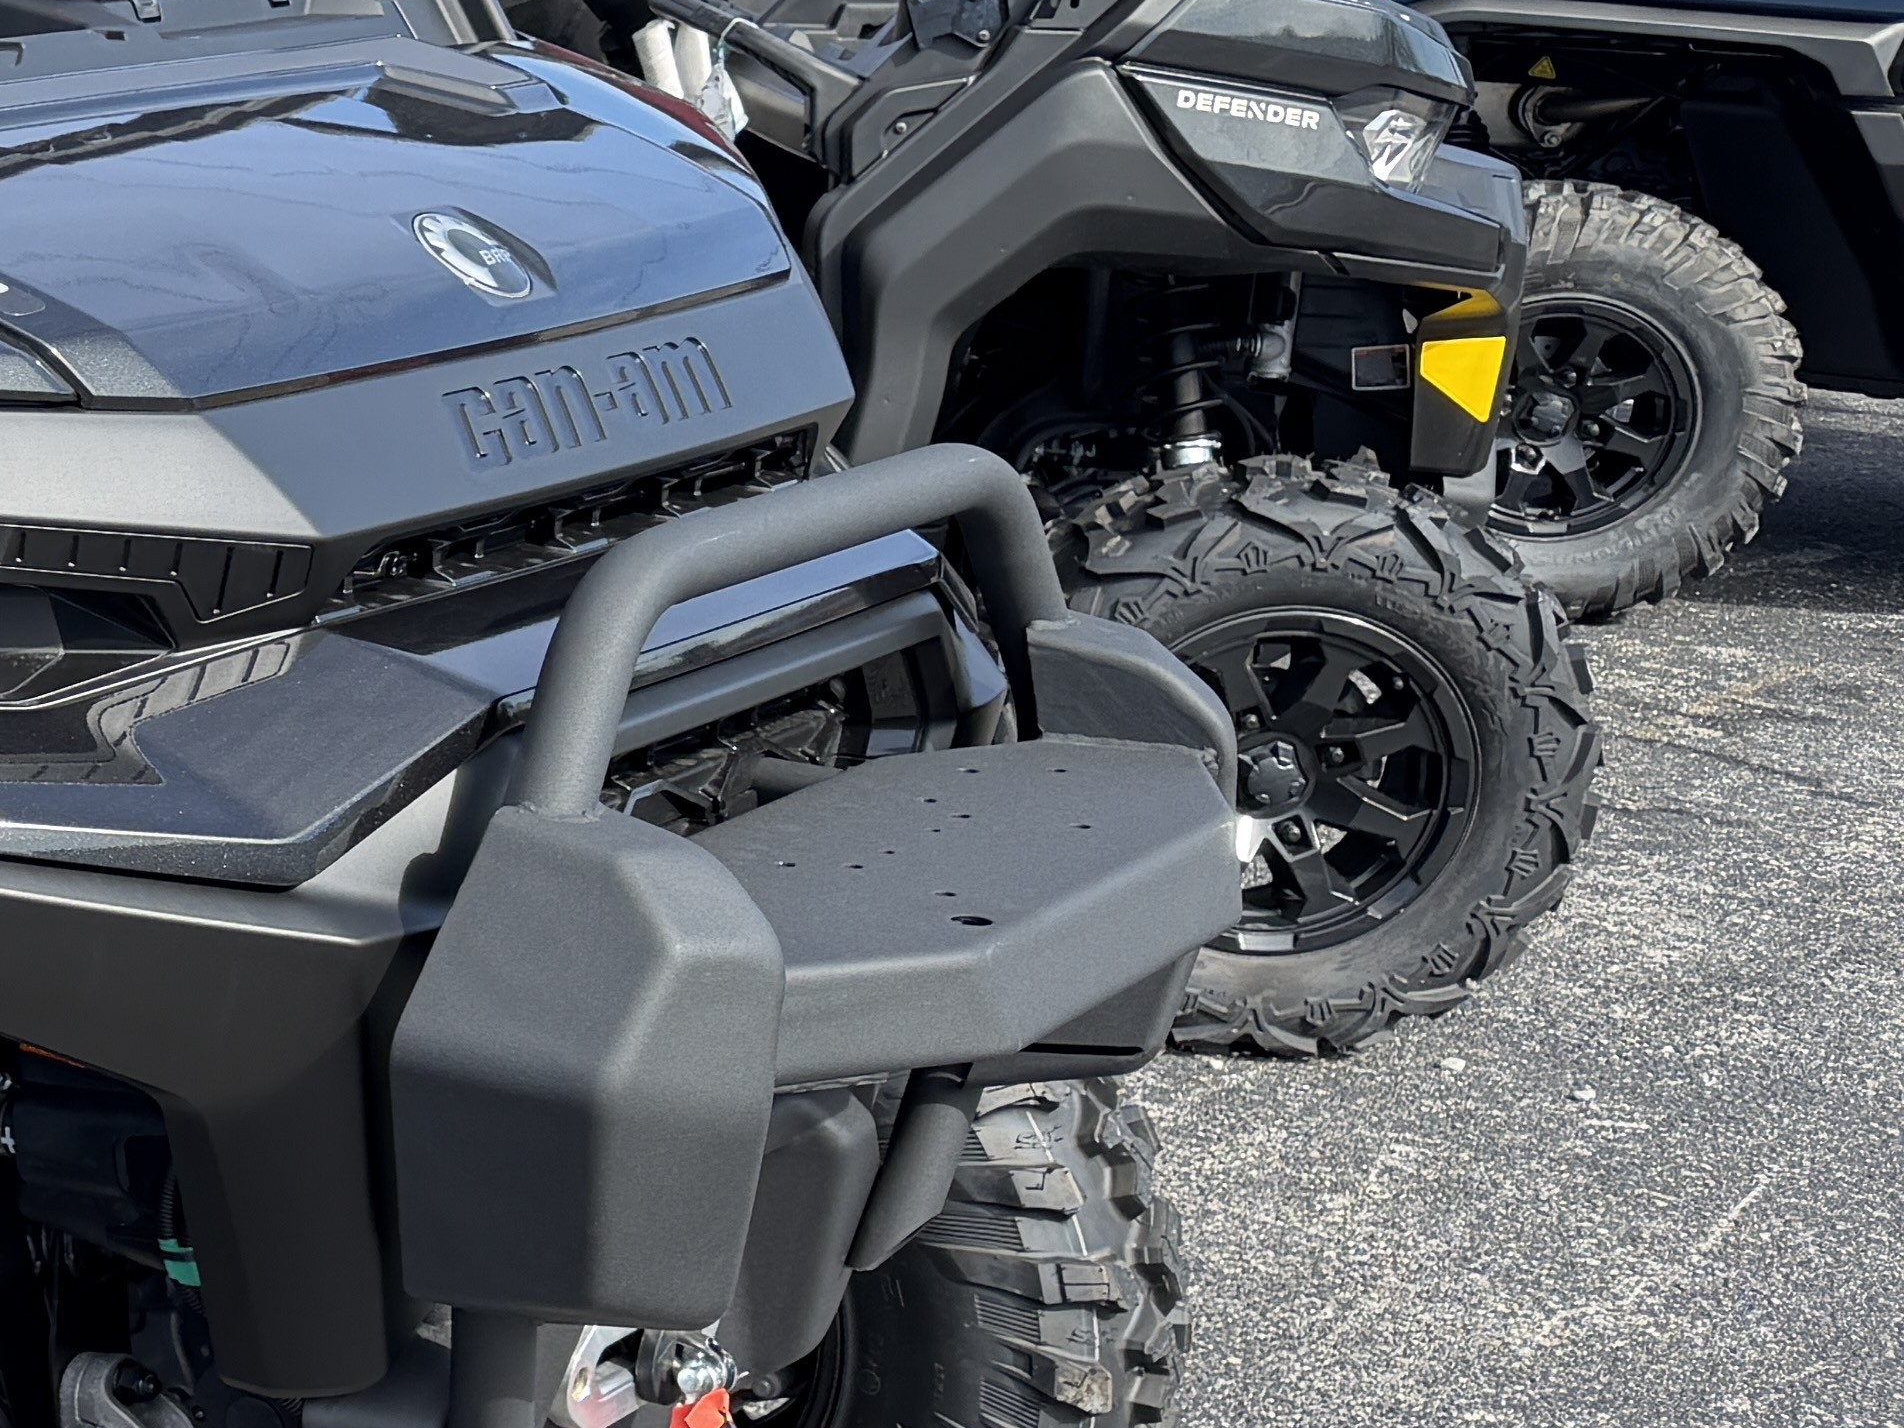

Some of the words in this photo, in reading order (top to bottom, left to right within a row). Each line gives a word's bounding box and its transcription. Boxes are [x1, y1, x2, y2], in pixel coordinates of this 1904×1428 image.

[1176, 88, 1320, 131] DEFENDER
[481, 247, 513, 267] BRP
[441, 335, 734, 469] can-am
